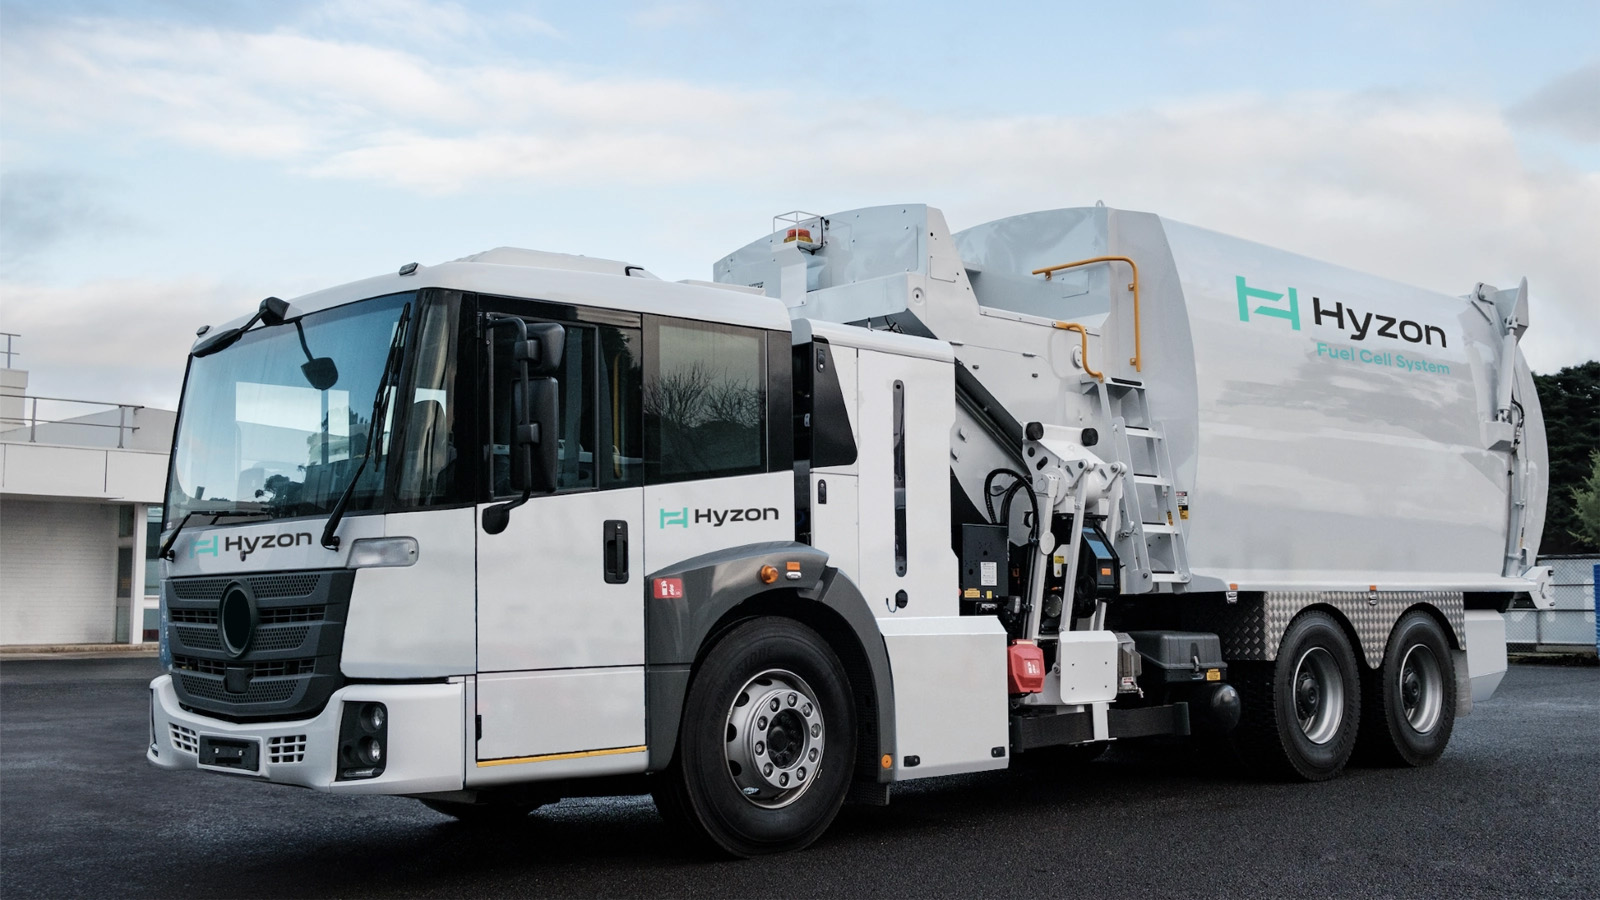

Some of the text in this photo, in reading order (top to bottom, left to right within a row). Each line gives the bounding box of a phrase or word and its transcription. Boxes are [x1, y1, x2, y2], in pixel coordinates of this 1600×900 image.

[1312, 296, 1447, 349] Hyzon
[1316, 342, 1451, 375] Fuel Cell System
[695, 507, 779, 527] Hyzon
[225, 532, 312, 554] Hyzon
